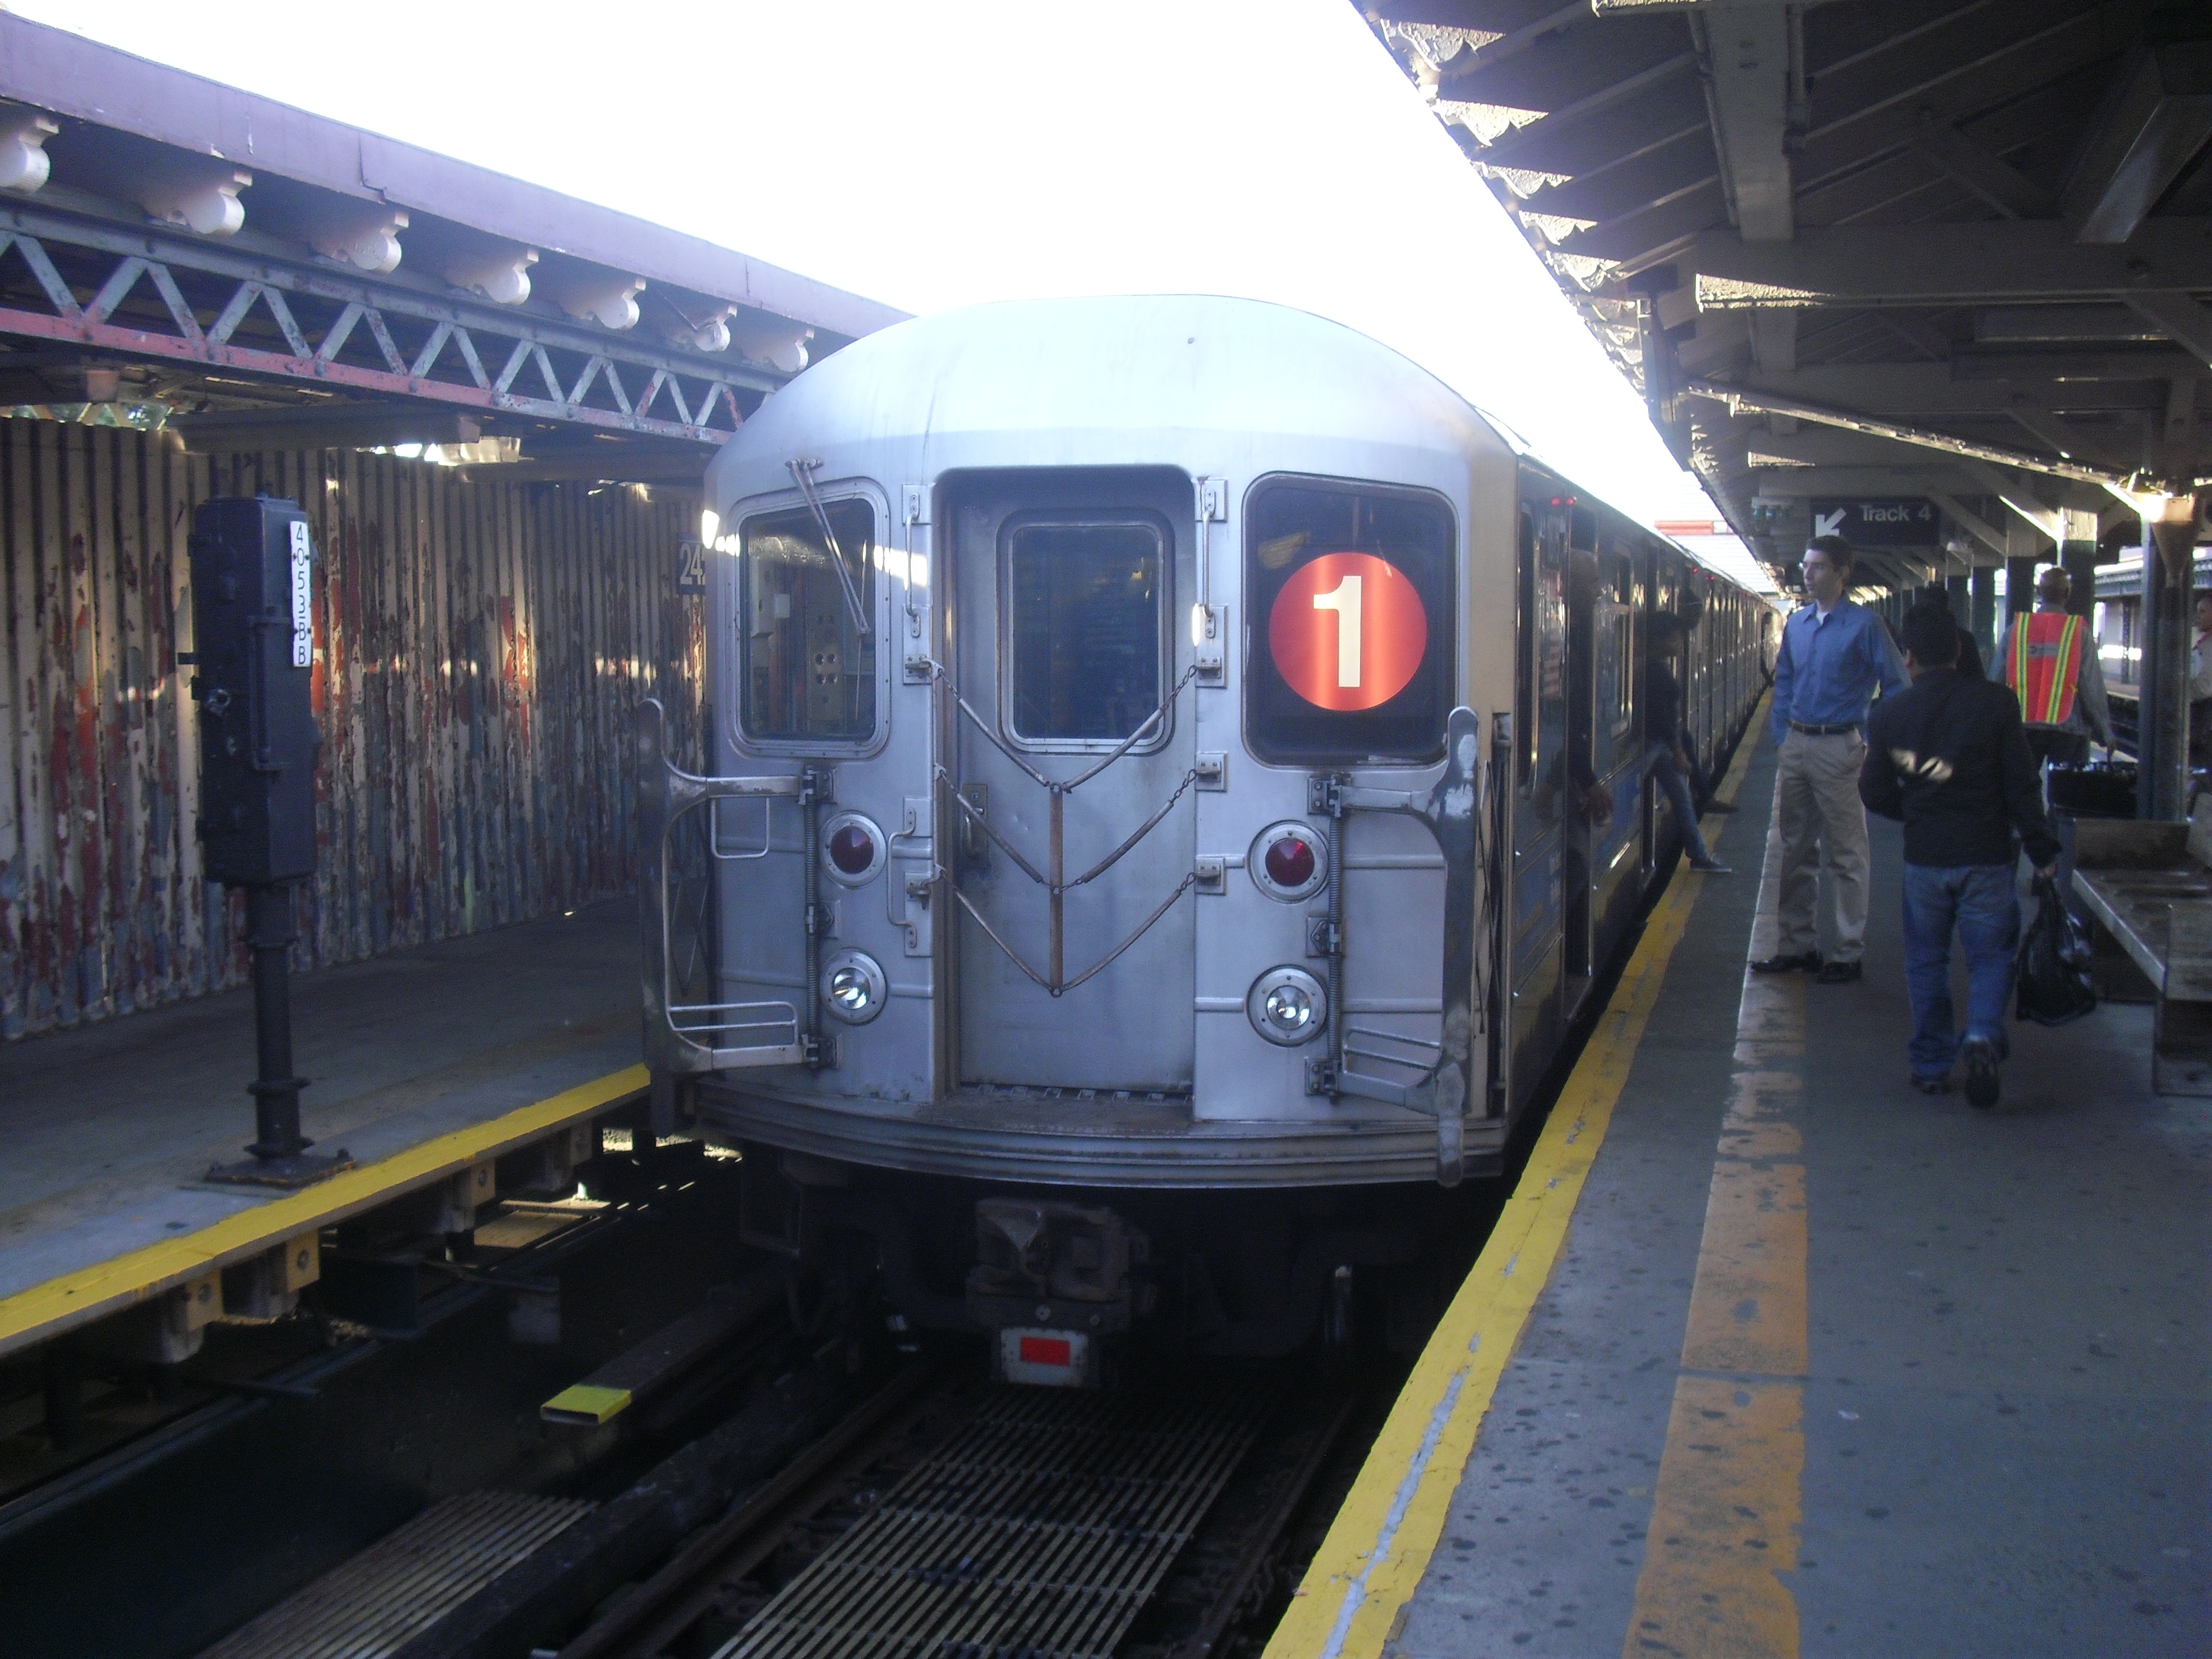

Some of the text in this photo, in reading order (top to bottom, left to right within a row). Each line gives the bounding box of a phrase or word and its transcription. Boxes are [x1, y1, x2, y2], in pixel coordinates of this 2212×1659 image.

[1859, 503, 1932, 522] Track 4
[680, 543, 706, 585] 24
[1313, 575, 1362, 688] 1
